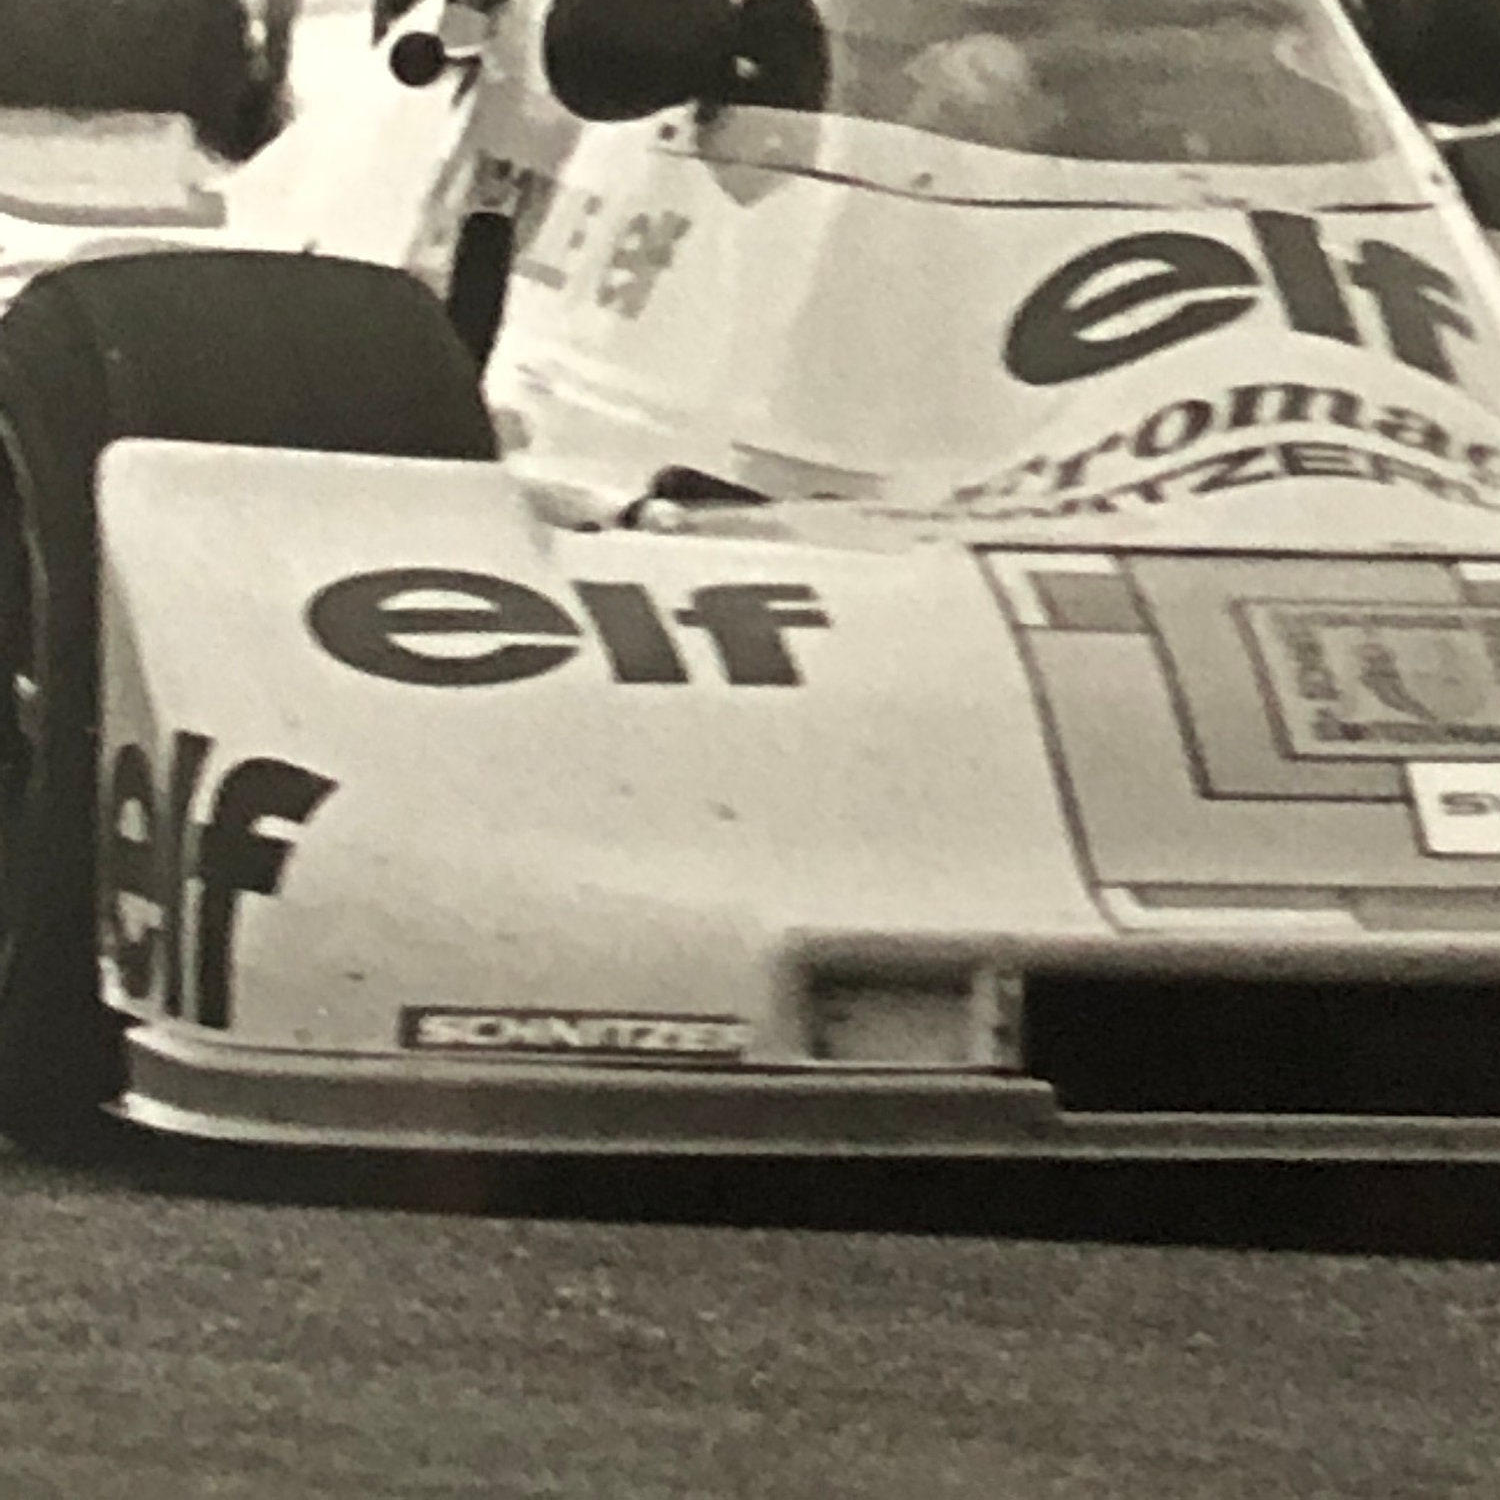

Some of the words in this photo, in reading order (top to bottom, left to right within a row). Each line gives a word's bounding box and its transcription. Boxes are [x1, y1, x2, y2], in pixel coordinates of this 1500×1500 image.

[1004, 209, 1478, 385] elf
[306, 567, 831, 687] elf
[102, 728, 340, 1029] elf
